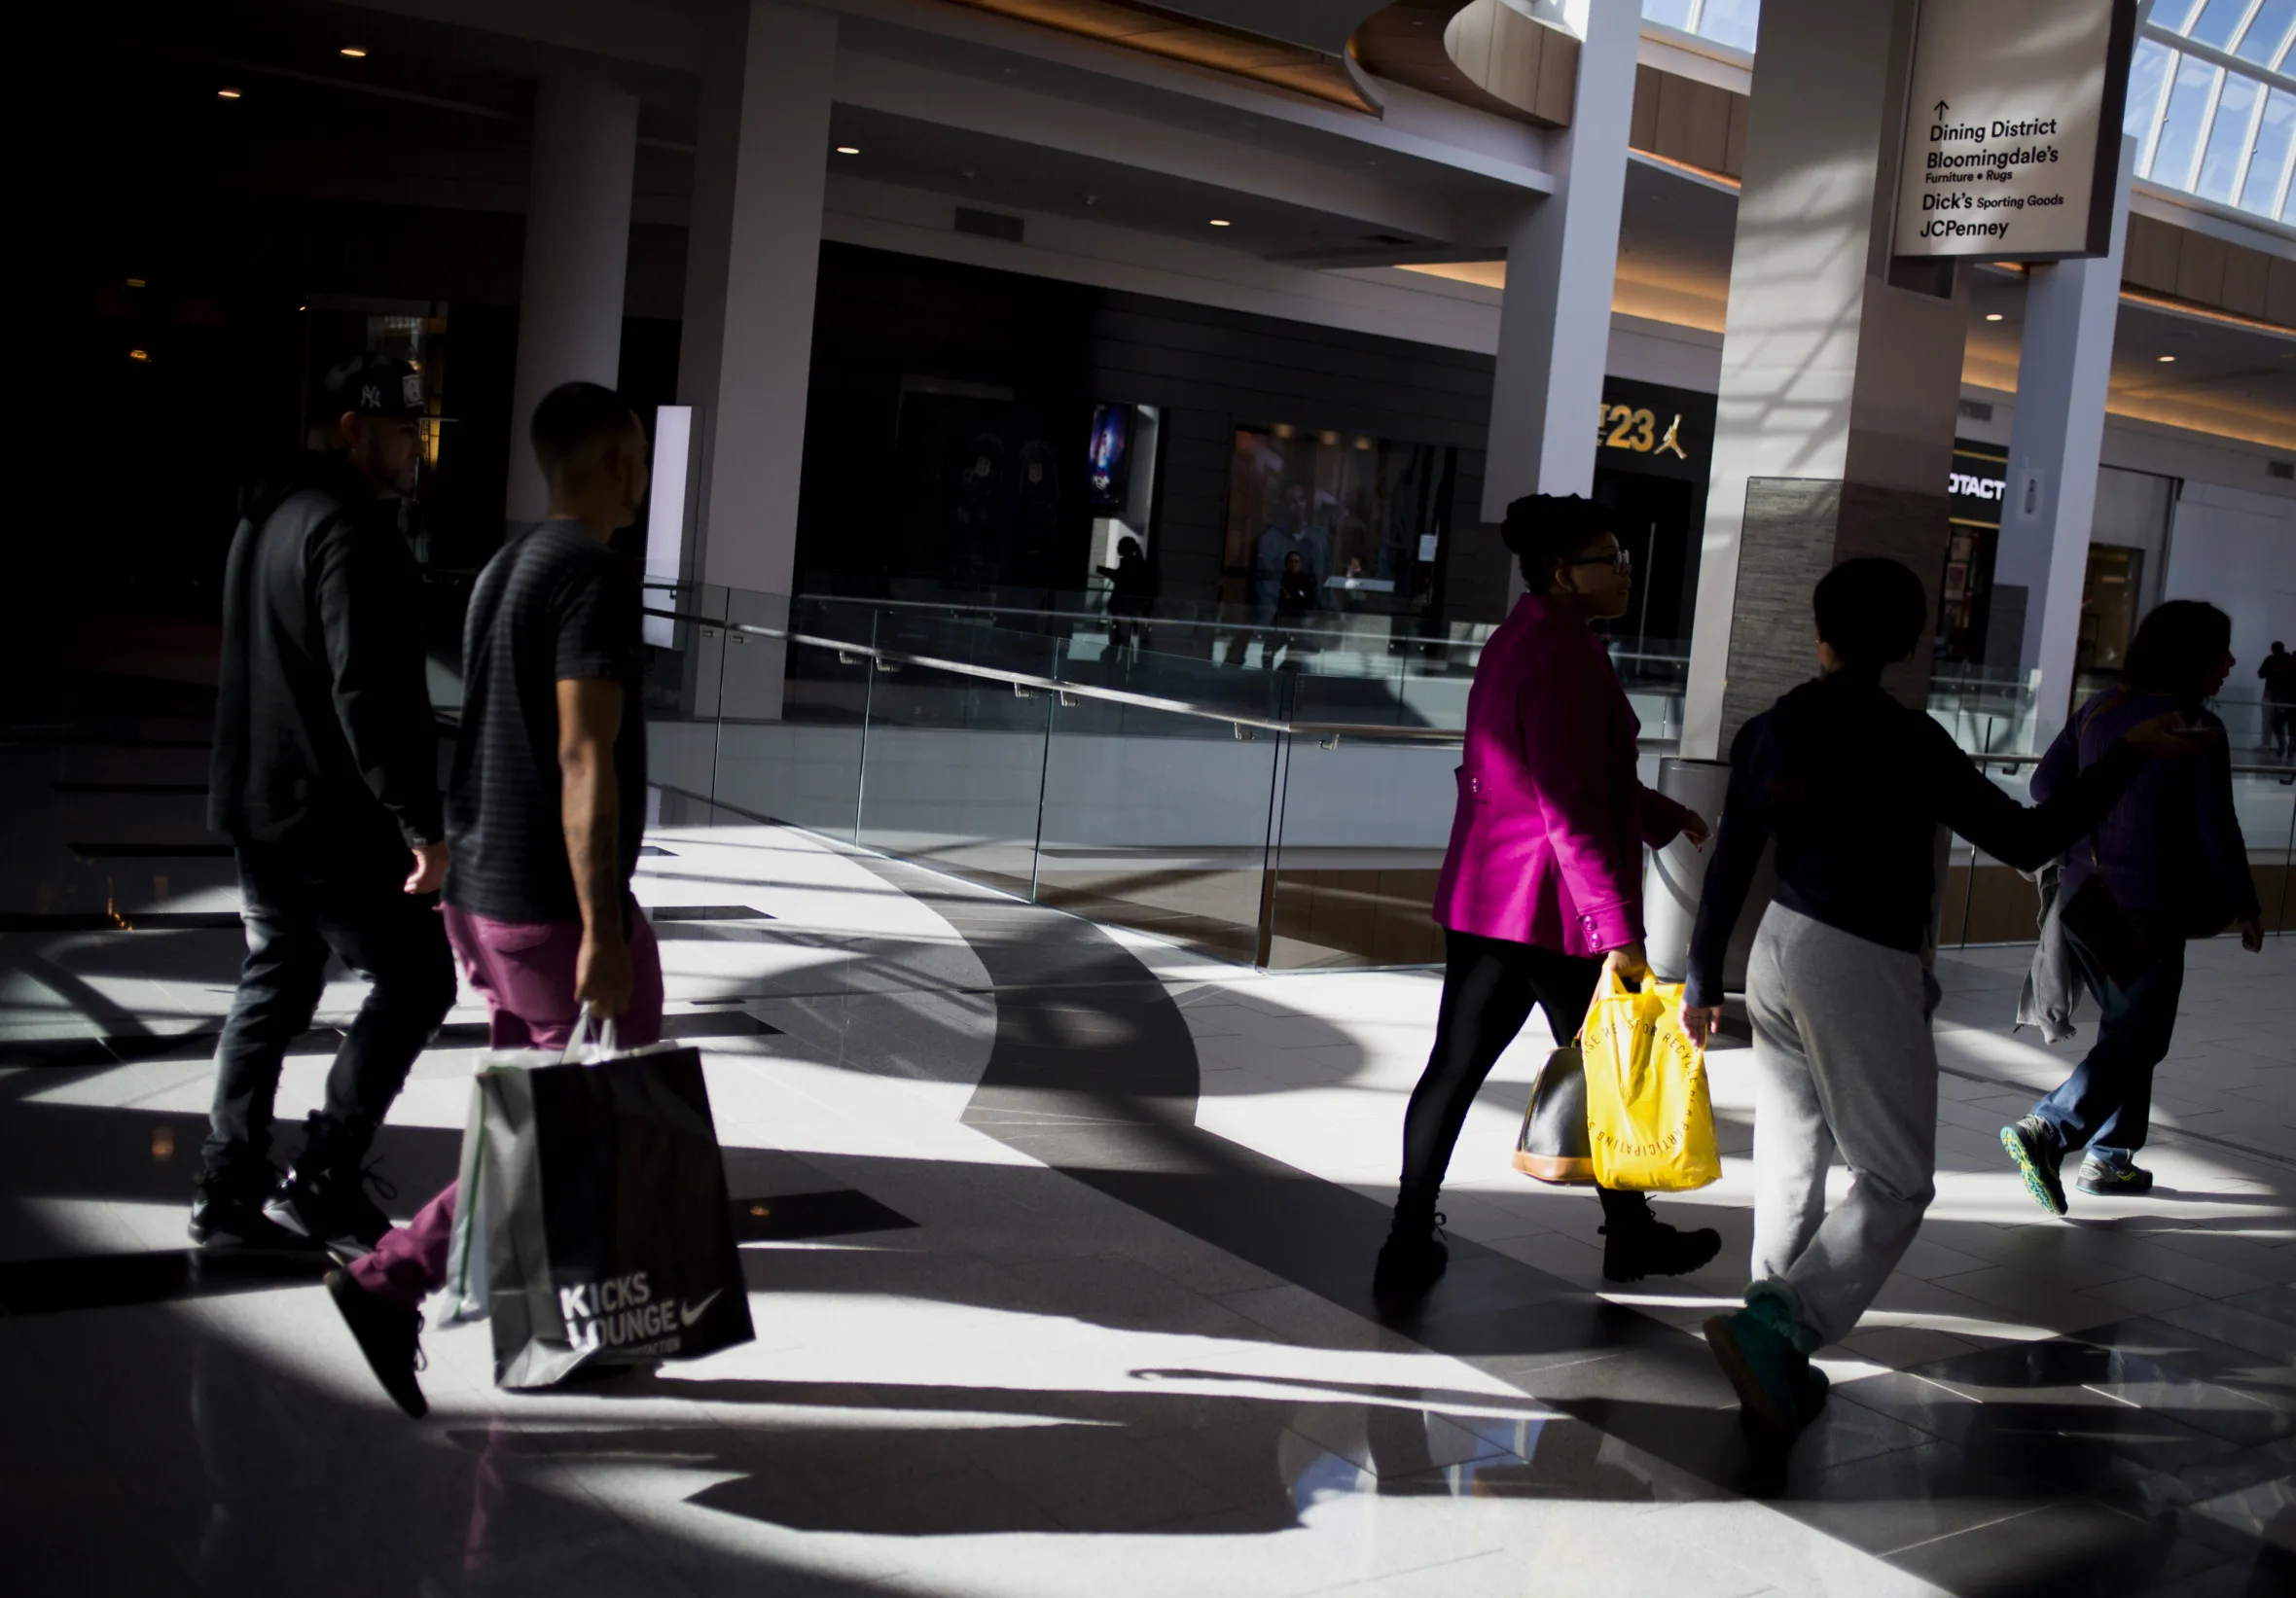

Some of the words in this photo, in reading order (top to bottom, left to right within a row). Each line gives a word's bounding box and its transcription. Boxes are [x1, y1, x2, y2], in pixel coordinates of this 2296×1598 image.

[1930, 124, 1986, 143] Dining
[1991, 118, 2057, 138] District
[1927, 145, 2059, 169] Bloomingdale's
[1925, 172, 1974, 184] Furniture
[1986, 170, 2013, 183] Rugs
[1922, 193, 1973, 210] Dick's
[1977, 196, 2024, 210] Sporting
[2027, 195, 2063, 206] Goods
[1920, 220, 2009, 239] JCPenney
[559, 1269, 652, 1320] KICKS
[566, 1299, 678, 1353] LOUNGE
